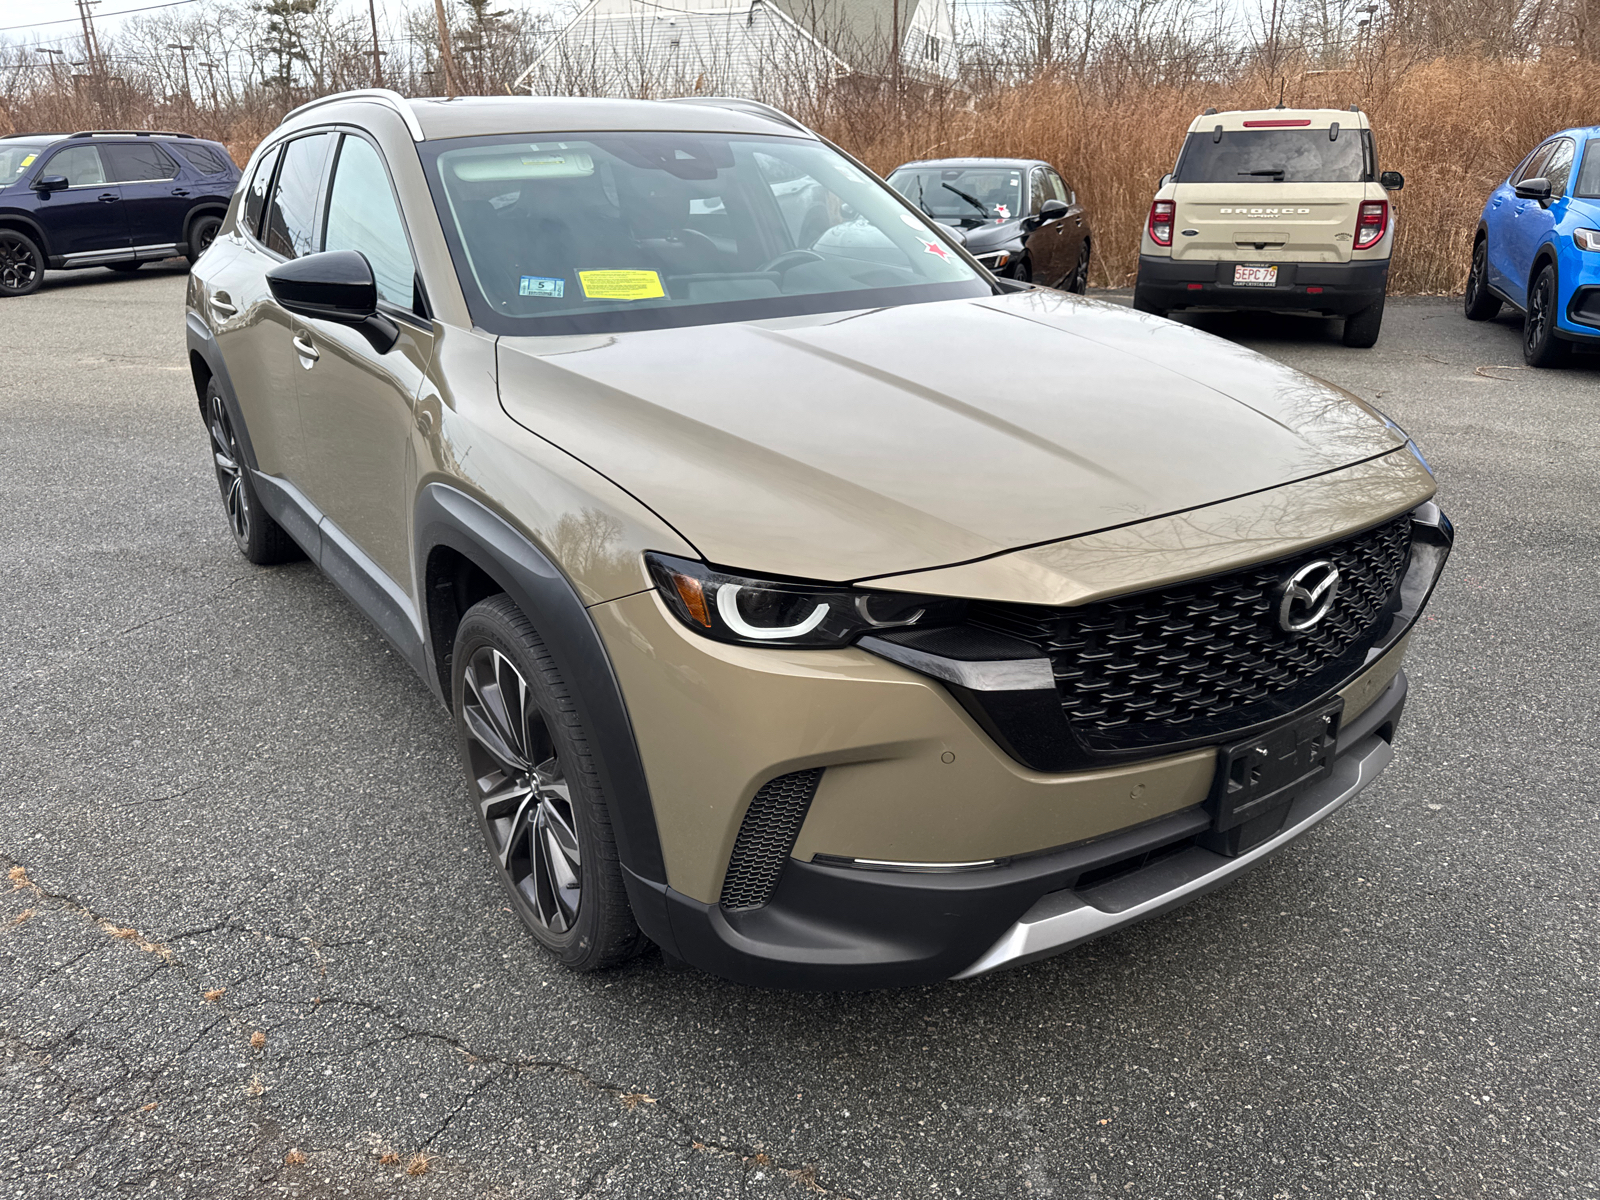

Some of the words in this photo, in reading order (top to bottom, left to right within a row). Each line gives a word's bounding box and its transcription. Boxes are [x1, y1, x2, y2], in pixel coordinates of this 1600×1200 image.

[1235, 268, 1261, 280] 5EPC
[1262, 269, 1276, 281] 79
[538, 281, 545, 289] 5
